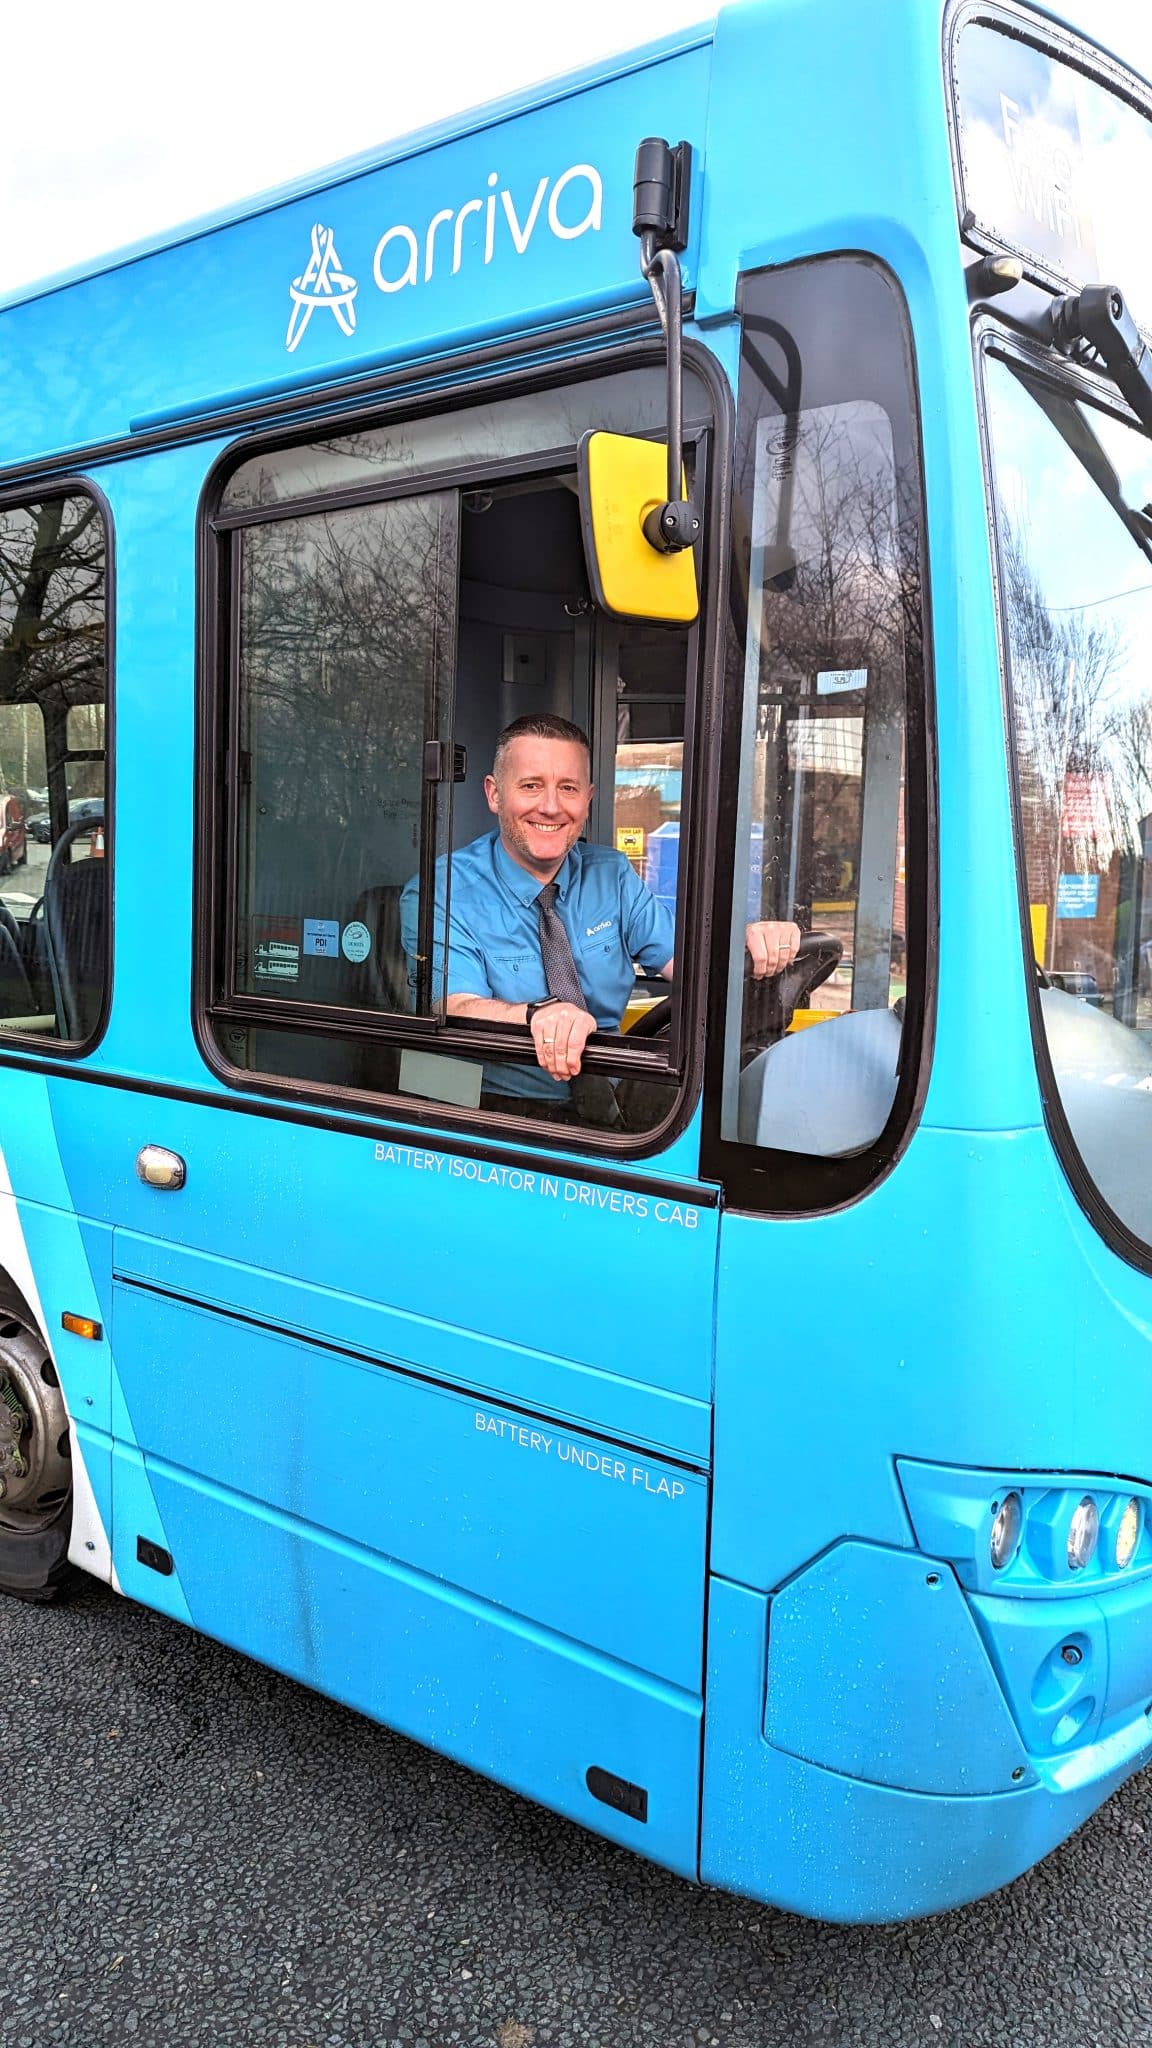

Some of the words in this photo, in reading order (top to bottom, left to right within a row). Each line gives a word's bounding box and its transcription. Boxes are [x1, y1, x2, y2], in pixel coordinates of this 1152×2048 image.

[372, 163, 603, 293] arriva
[315, 938, 327, 948] PDI
[374, 1143, 446, 1175] BATTERY
[448, 1159, 535, 1193] ISOLATOR
[540, 1177, 559, 1199] IN
[564, 1183, 649, 1217] DRIVERS
[654, 1202, 699, 1229] CAB
[475, 1412, 553, 1454] BATTERY
[557, 1442, 626, 1482] UNDER
[631, 1467, 685, 1501] FLAP
